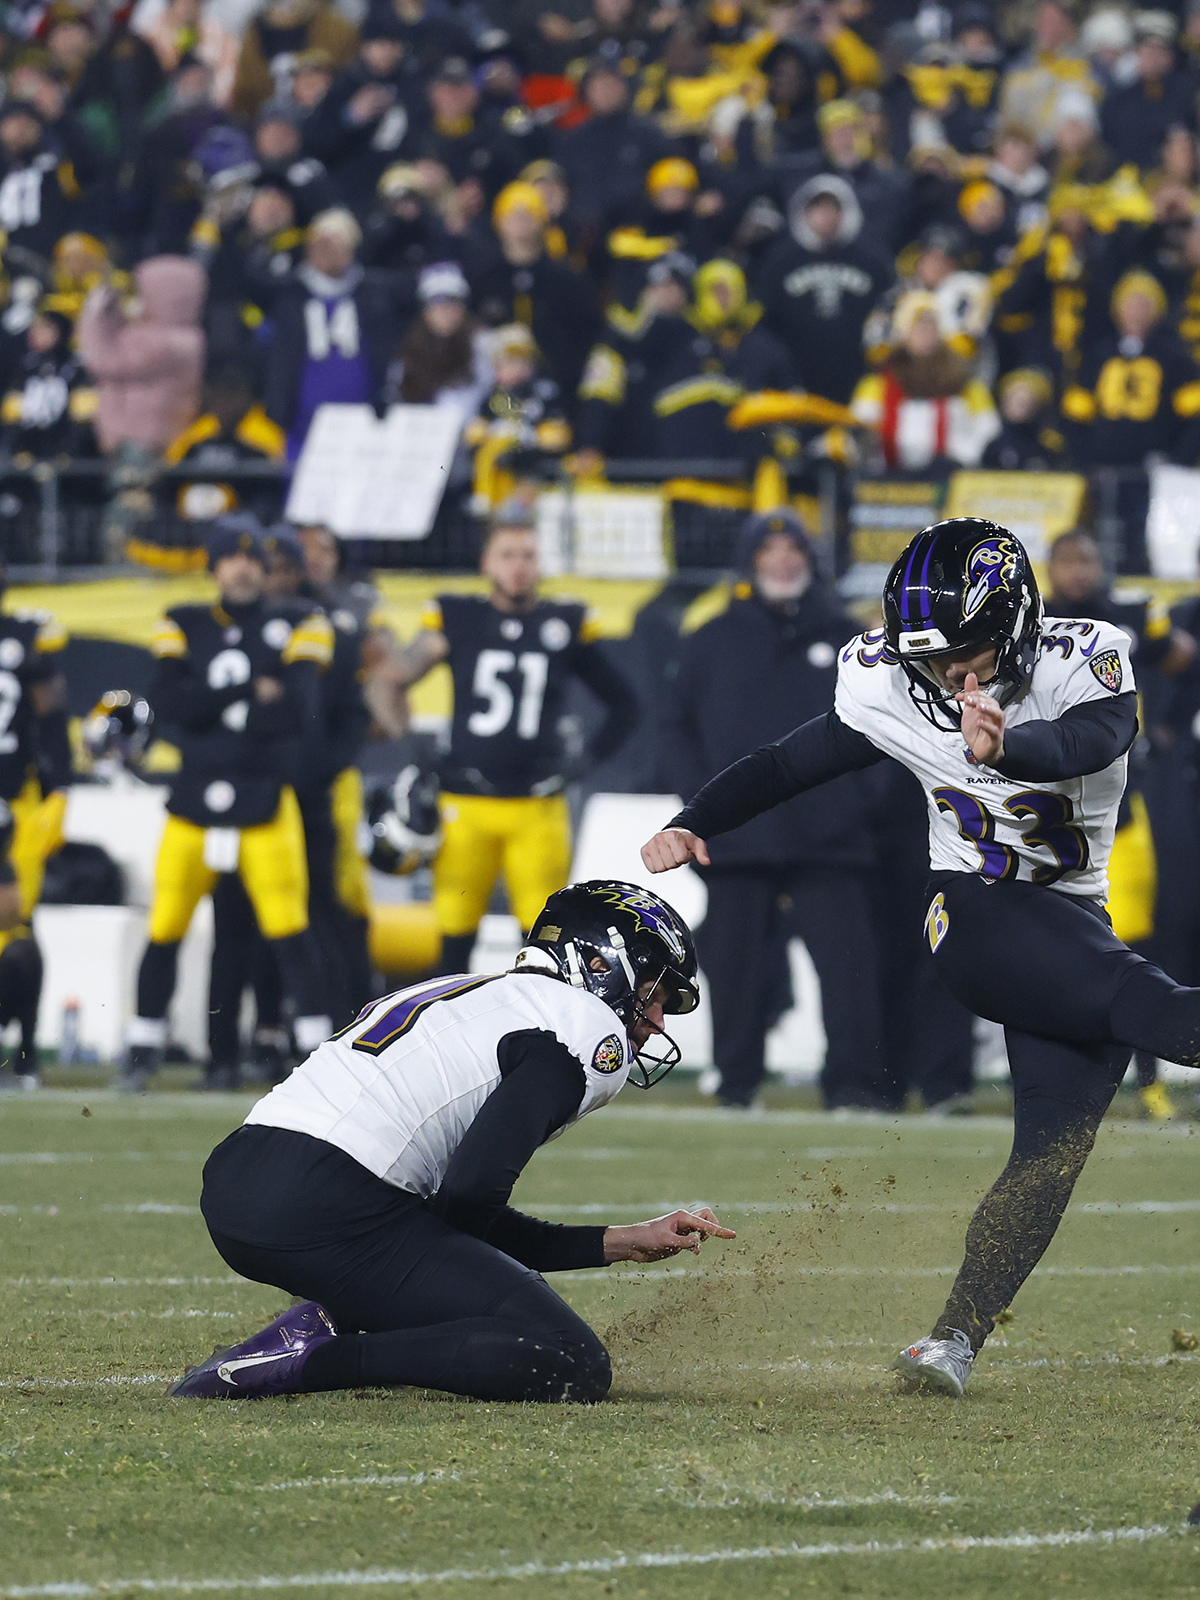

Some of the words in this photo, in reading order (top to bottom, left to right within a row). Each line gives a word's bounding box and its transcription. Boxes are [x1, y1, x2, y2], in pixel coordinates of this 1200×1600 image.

[466, 649, 549, 740] 51
[965, 776, 1014, 786] RAVENS
[931, 786, 1089, 885] 33
[923, 892, 950, 954] B
